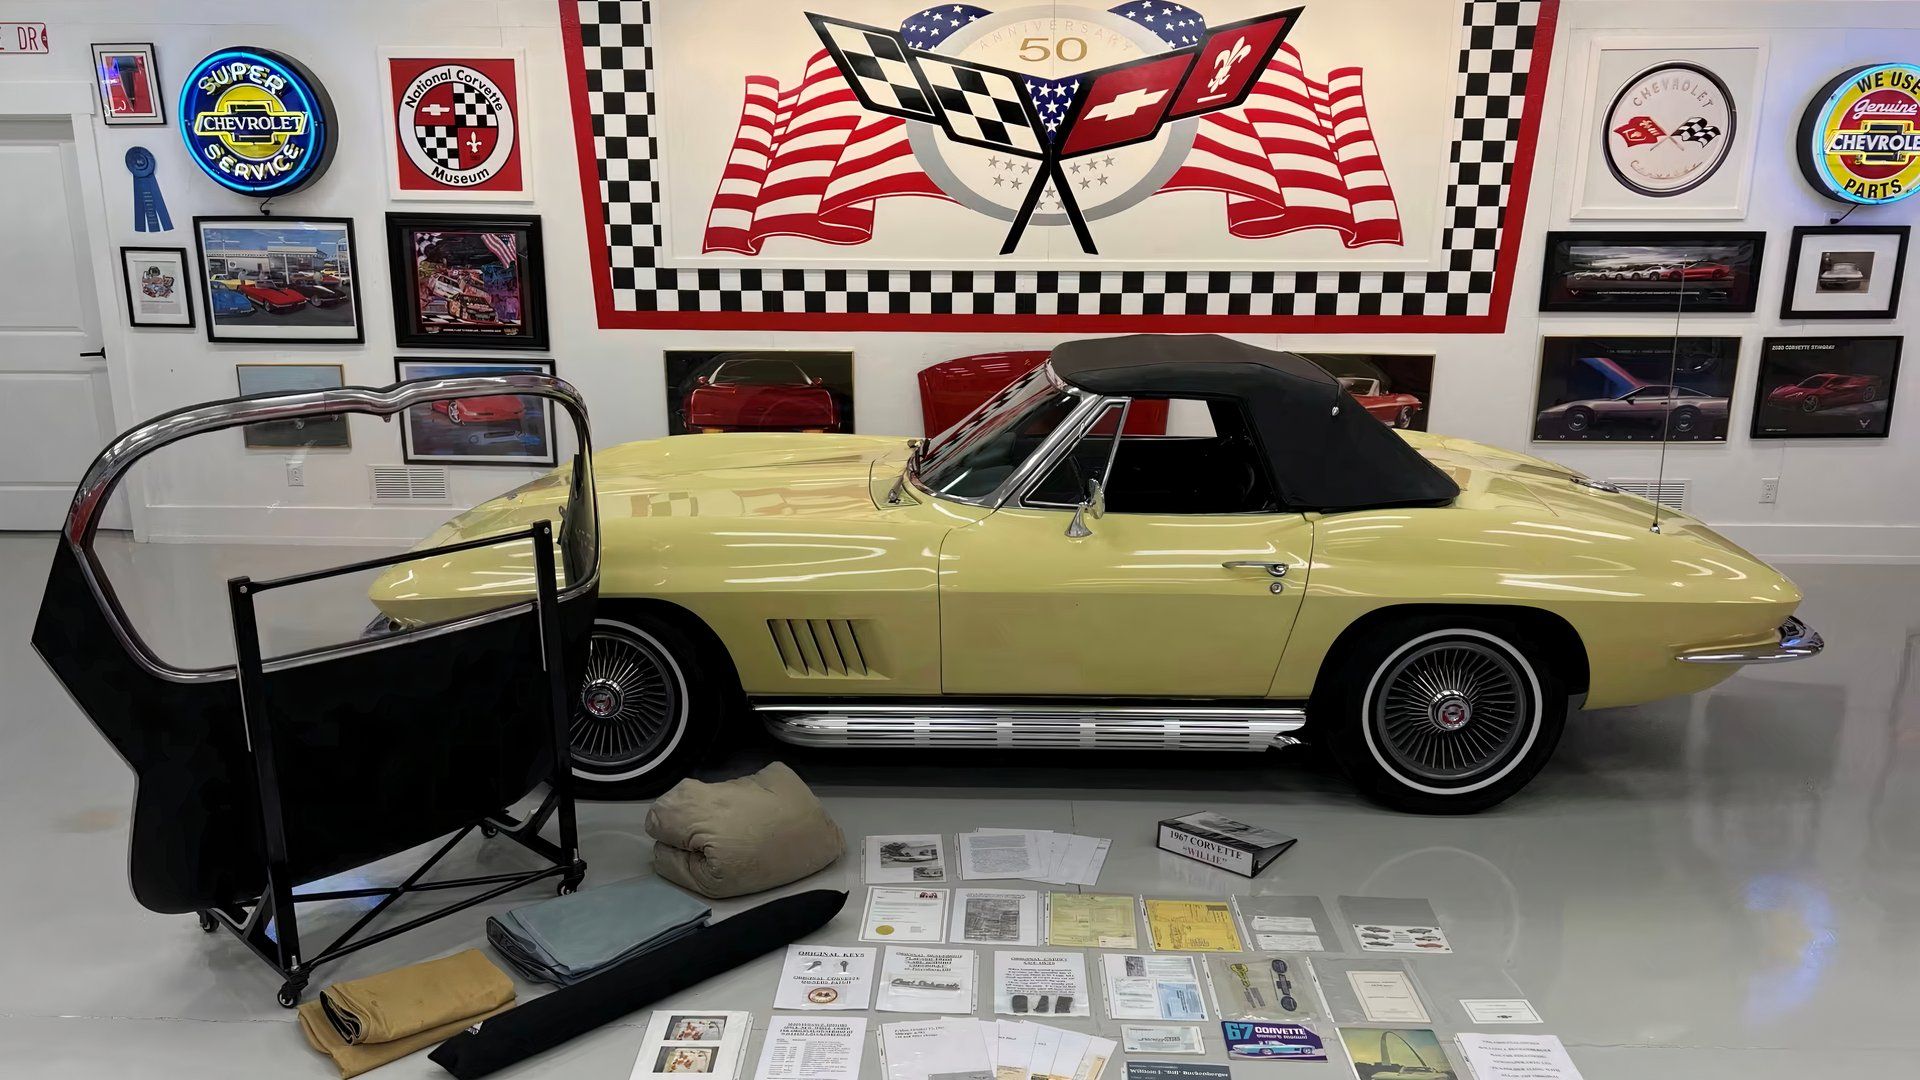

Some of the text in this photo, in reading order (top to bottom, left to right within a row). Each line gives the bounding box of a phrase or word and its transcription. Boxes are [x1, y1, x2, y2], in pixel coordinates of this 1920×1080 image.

[17, 26, 39, 50] DR
[979, 20, 1133, 51] ANNIVERSARY
[1018, 37, 1088, 62] 50
[198, 62, 286, 96] SUPER
[404, 68, 503, 112] National Corvette
[1856, 71, 1884, 94] WE
[1633, 78, 1714, 108] CHEVROLET
[1852, 98, 1918, 120] Genuine
[203, 116, 302, 131] CHEVROLET
[1832, 134, 1920, 151] CHEVROLE
[204, 143, 304, 181] SERVICE
[431, 166, 490, 184] Museum
[1843, 178, 1902, 199] PARTS
[1170, 830, 1242, 860] 1967 CORVETTE
[1224, 1022, 1306, 1040] 67 CORVETTE
